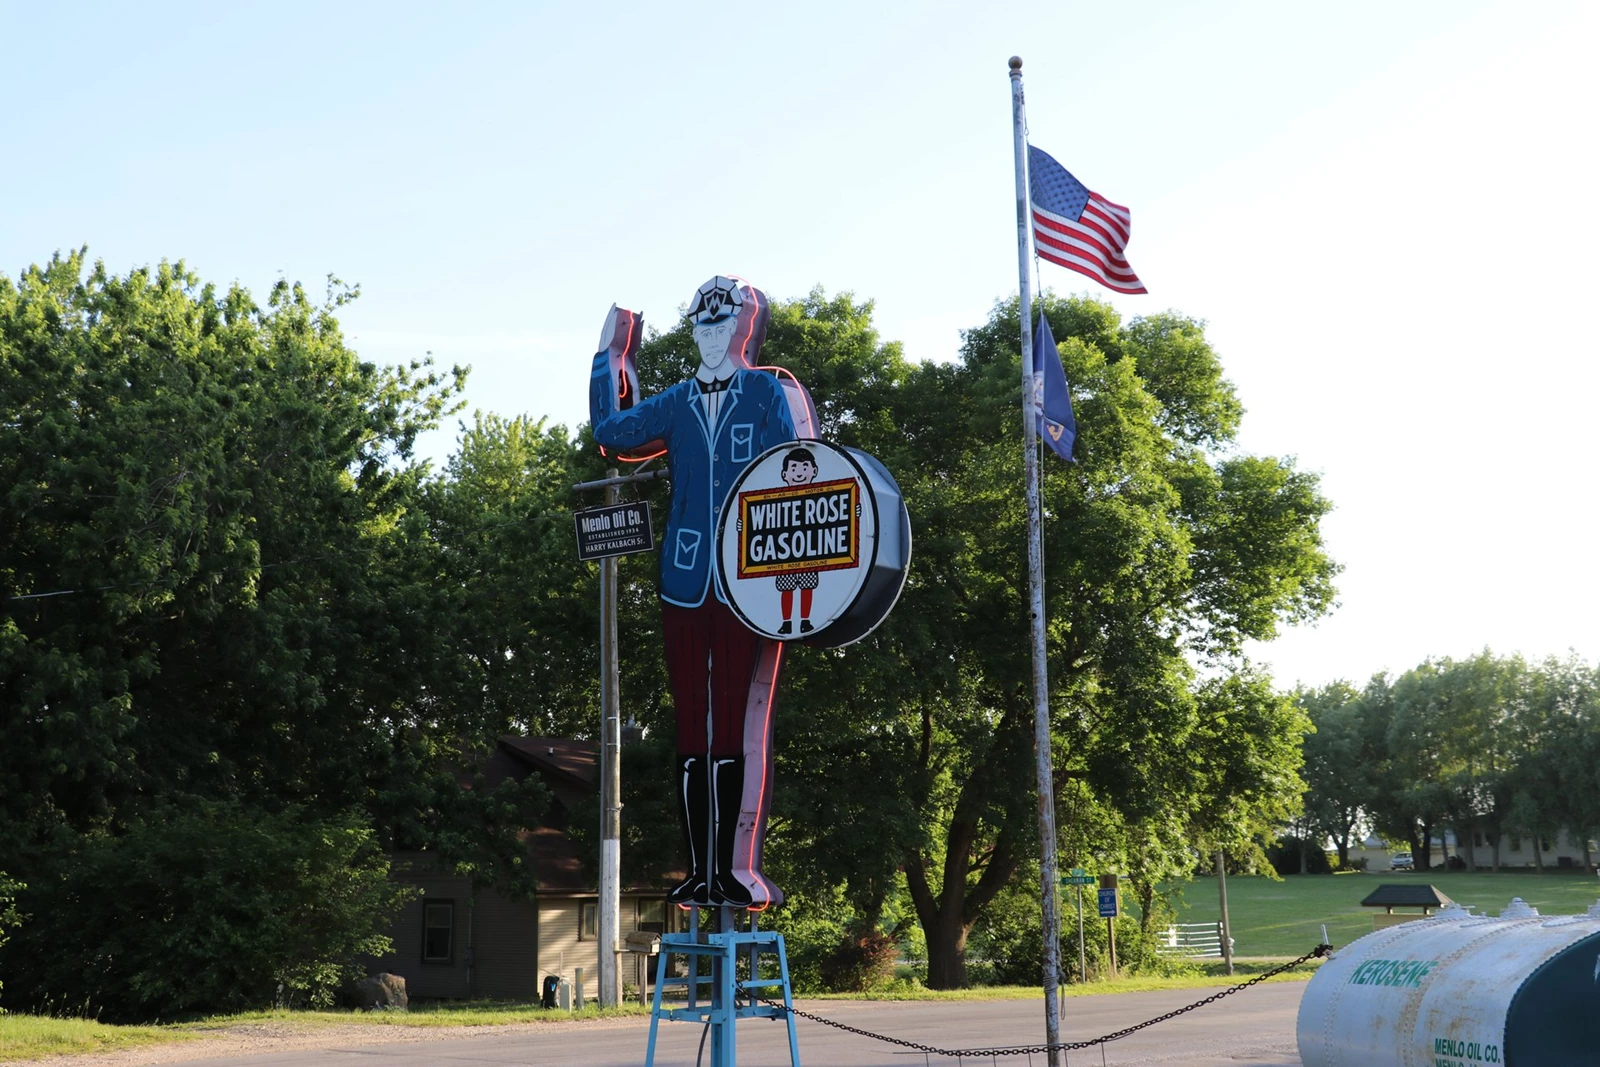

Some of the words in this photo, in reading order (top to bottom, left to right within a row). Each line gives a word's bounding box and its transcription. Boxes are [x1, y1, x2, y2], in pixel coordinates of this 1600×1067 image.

[581, 514, 611, 533] Menlo
[612, 510, 626, 528] Oil
[627, 509, 644, 526] Co.
[750, 500, 802, 531] WHITE
[805, 494, 849, 525] ROSE
[585, 542, 607, 553] HARRY
[607, 539, 636, 550] KALBACH
[636, 537, 646, 545] Sr.
[588, 530, 625, 540] ESTABLISHED
[750, 526, 849, 562] GASOLINE
[1348, 959, 1440, 988] KEROSENE
[1434, 1038, 1465, 1058] MENLO
[1467, 1042, 1482, 1060] OIL
[1485, 1044, 1500, 1063] CO.
